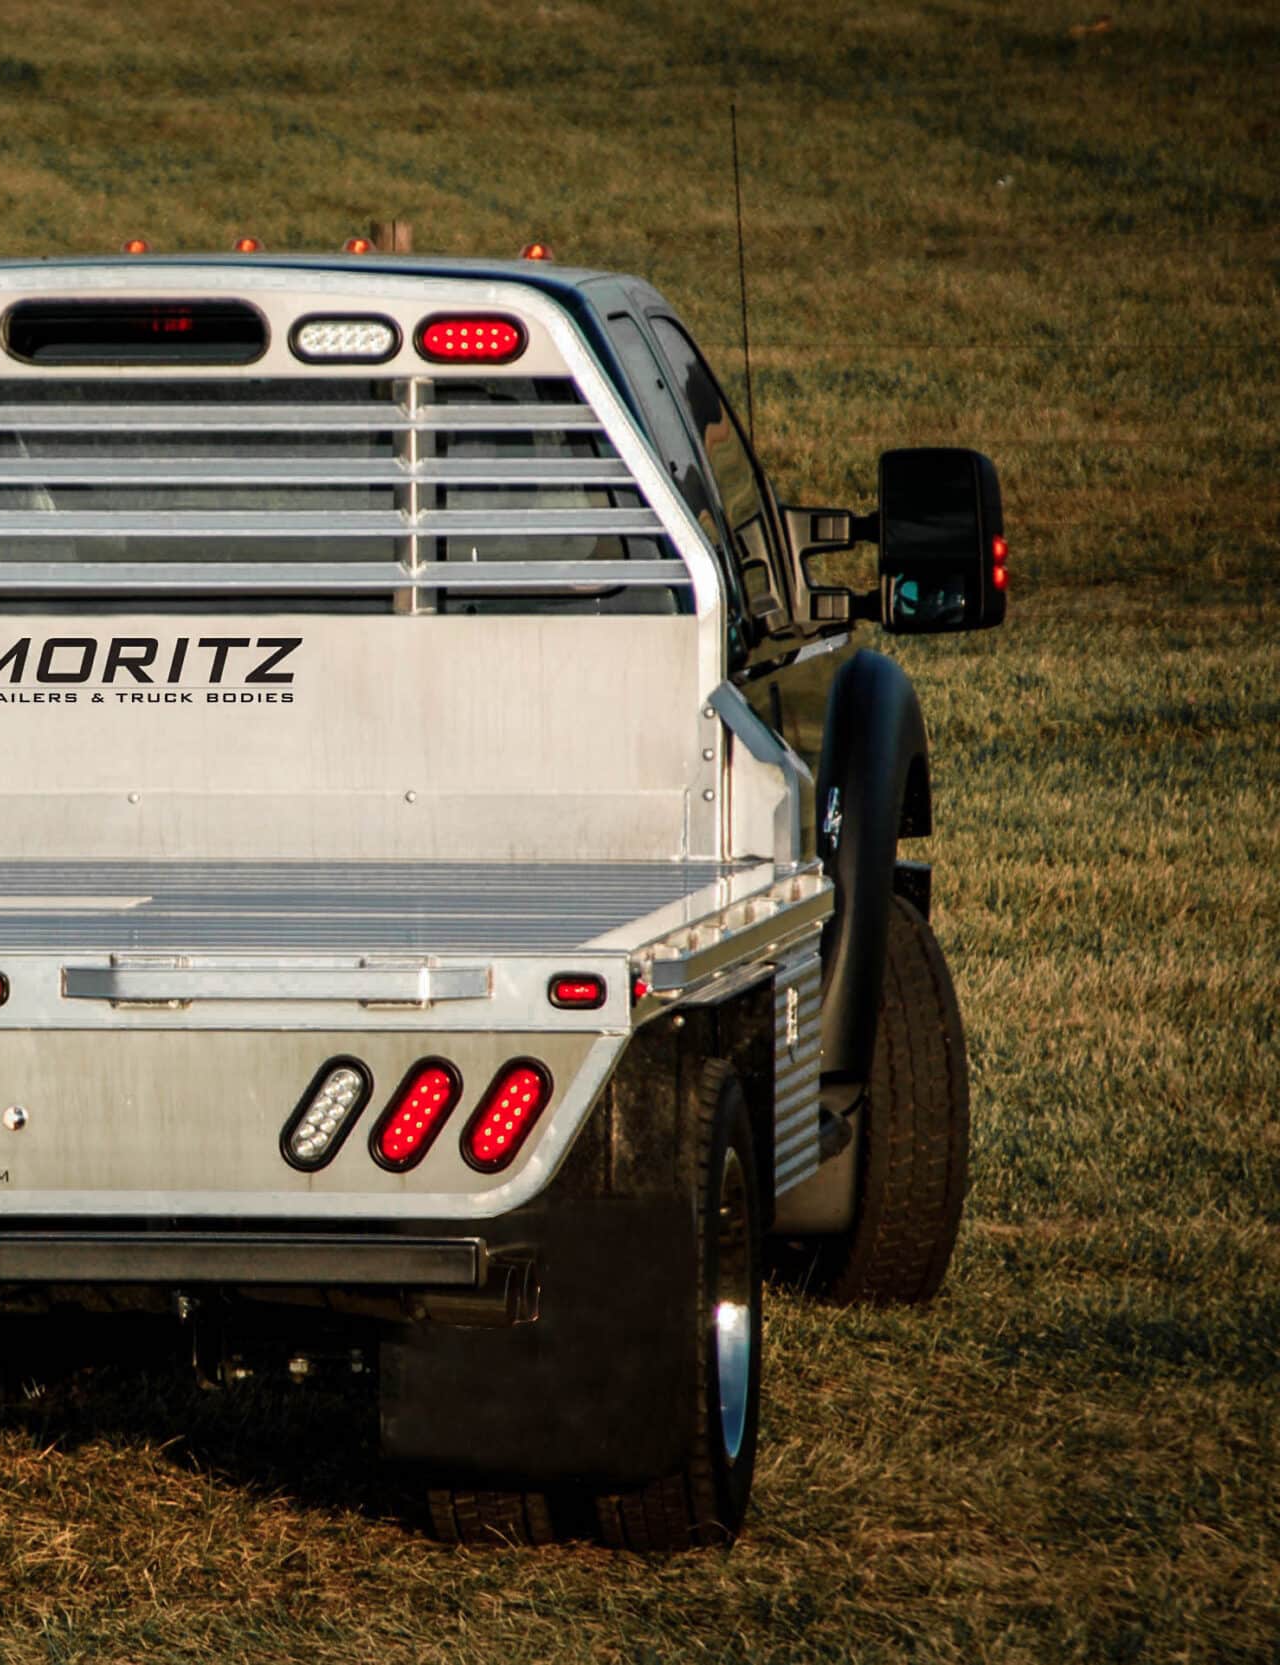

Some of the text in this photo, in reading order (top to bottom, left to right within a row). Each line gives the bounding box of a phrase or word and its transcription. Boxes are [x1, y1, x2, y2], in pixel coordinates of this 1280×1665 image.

[91, 692, 106, 704] &
[115, 692, 194, 704] TRUCK
[206, 692, 295, 704] BODIES
